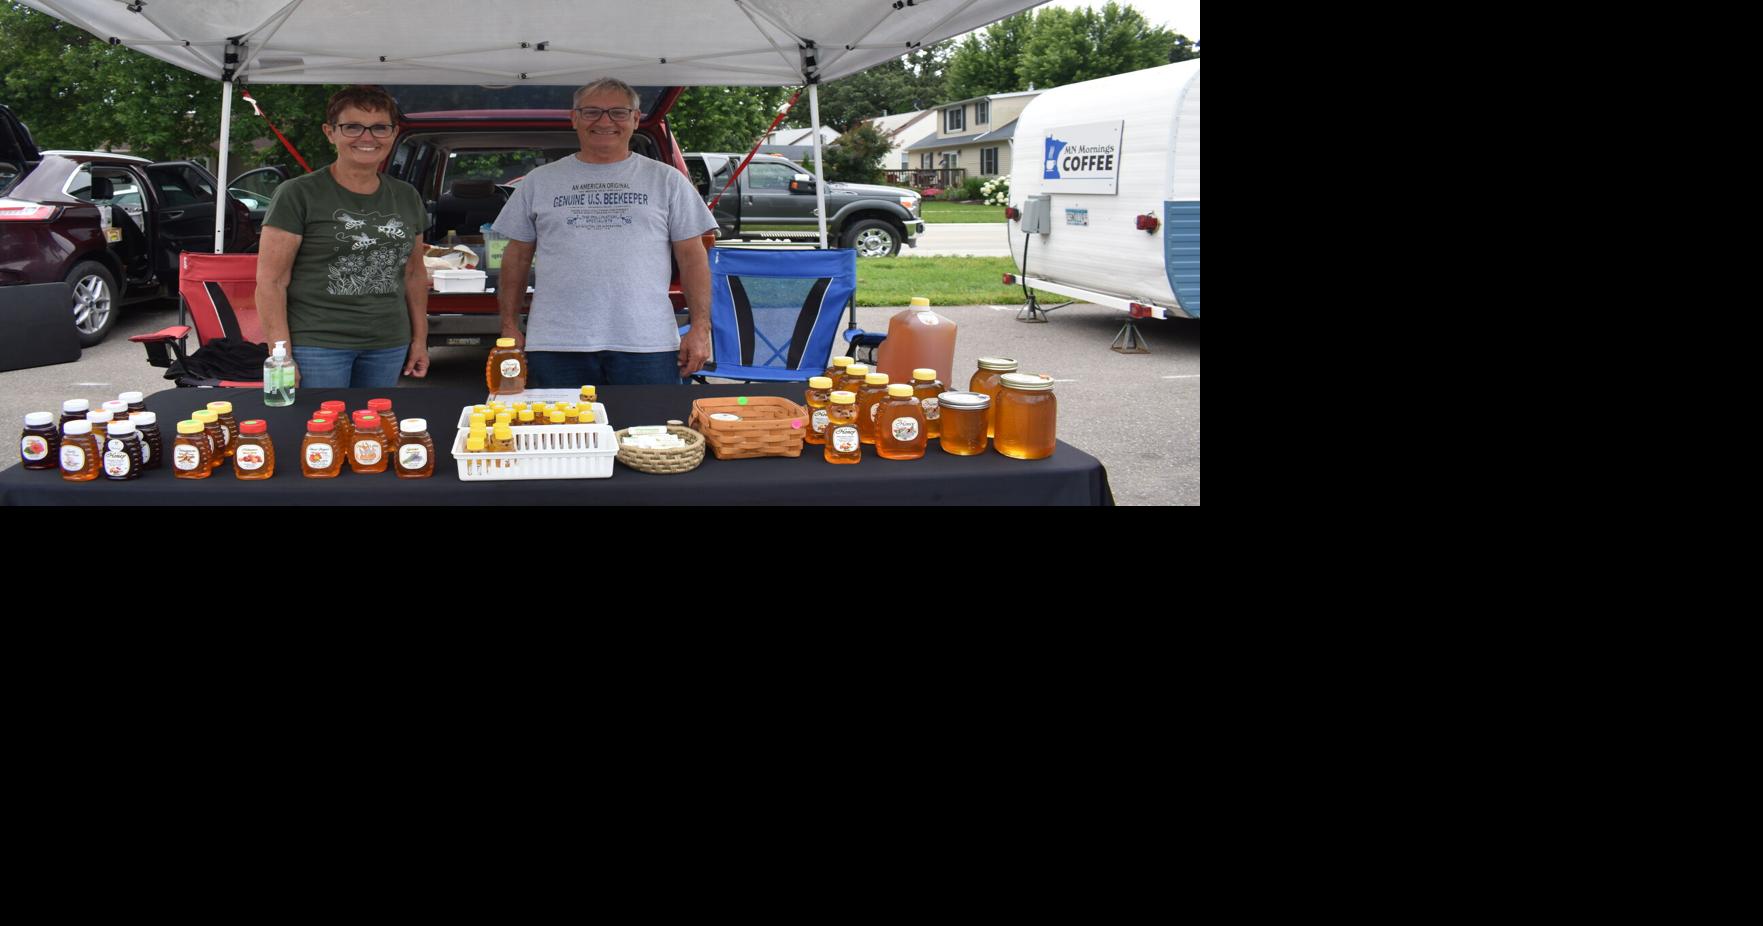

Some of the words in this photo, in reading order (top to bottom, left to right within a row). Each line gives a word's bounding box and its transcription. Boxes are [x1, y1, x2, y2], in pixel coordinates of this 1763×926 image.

[1064, 145, 1077, 154] MN
[1078, 144, 1114, 154] Mornings
[1063, 154, 1113, 171] COFFEE
[553, 194, 586, 207] GENUINE
[588, 193, 602, 205] U.S.
[604, 192, 648, 205] BEEKEEPER
